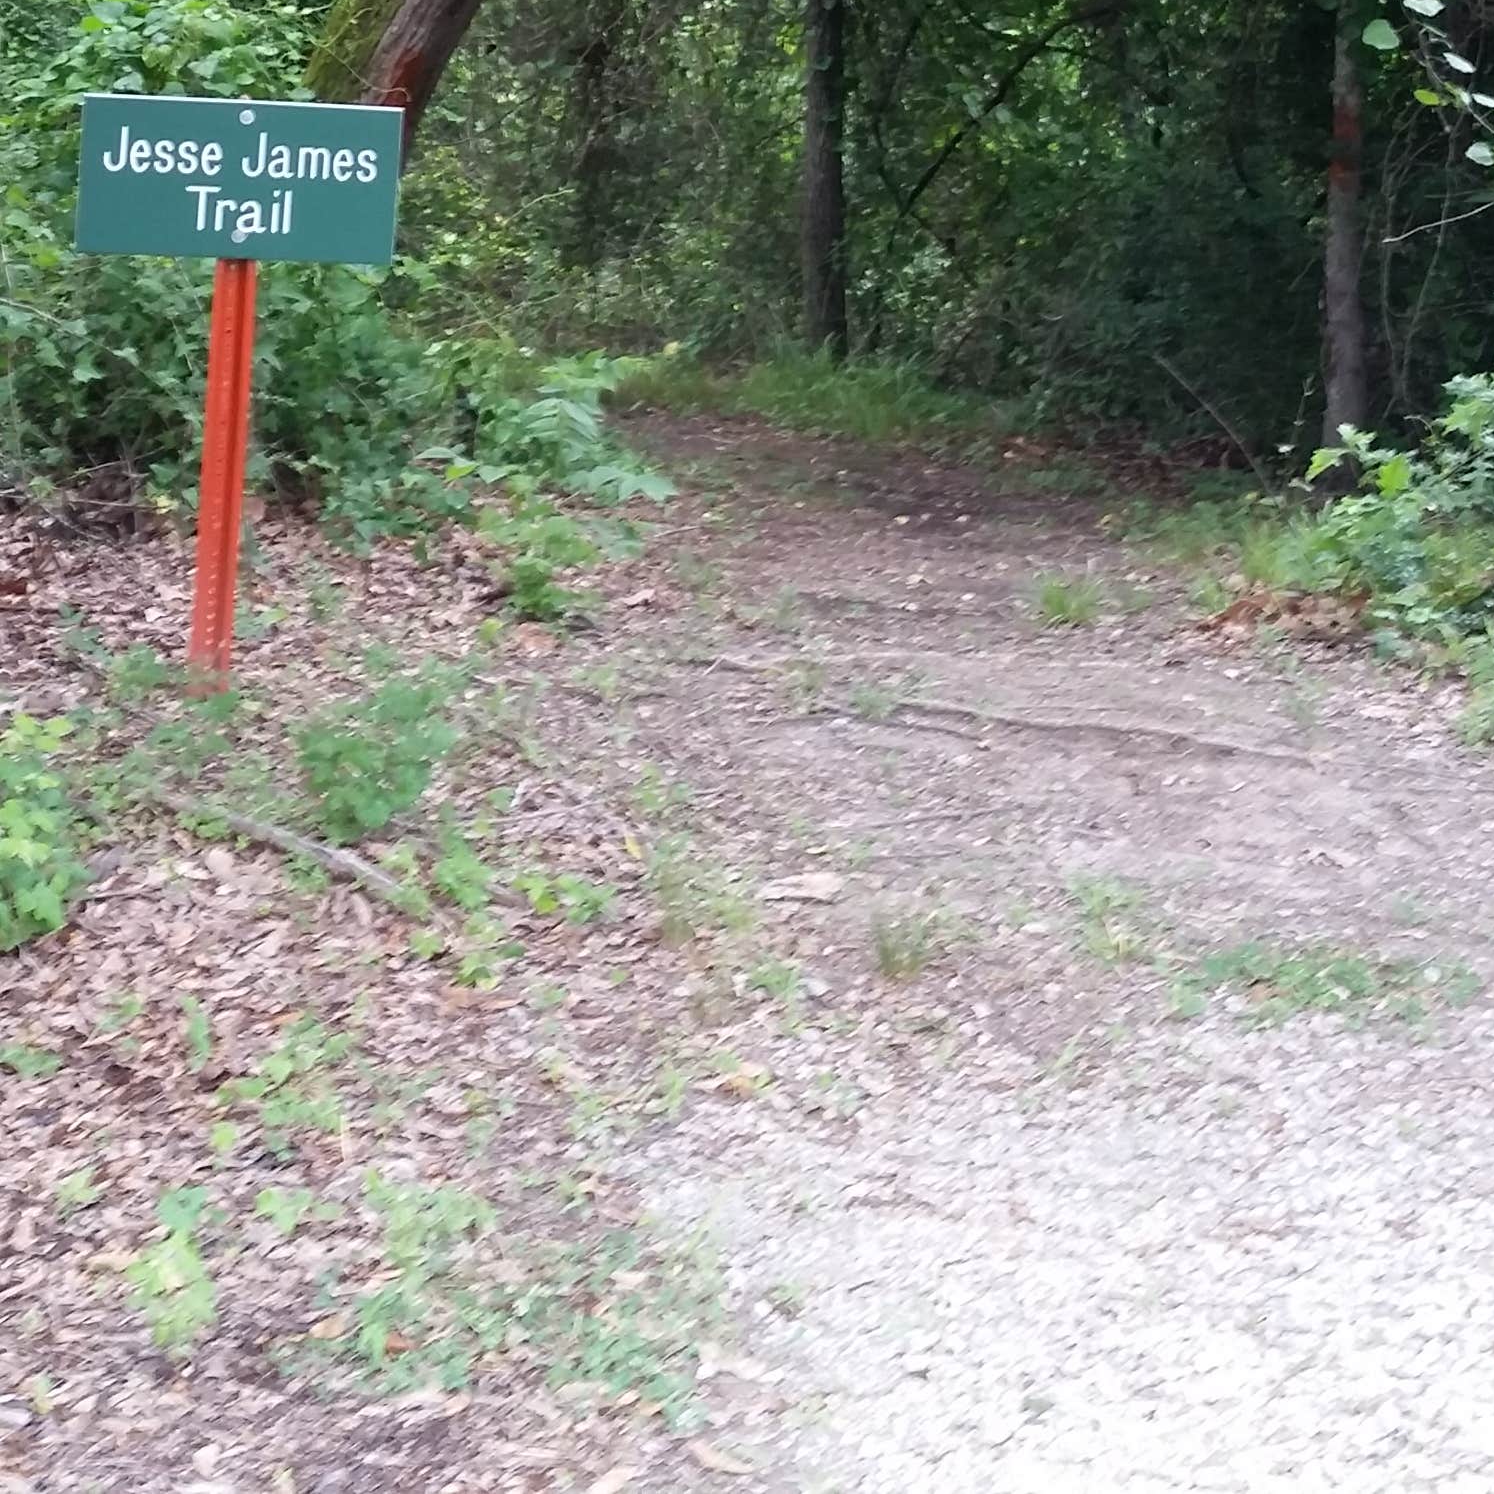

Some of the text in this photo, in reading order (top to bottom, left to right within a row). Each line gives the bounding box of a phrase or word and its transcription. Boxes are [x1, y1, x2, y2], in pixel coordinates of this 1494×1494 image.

[102, 125, 378, 183] Jesse James
[185, 185, 293, 235] Trail
